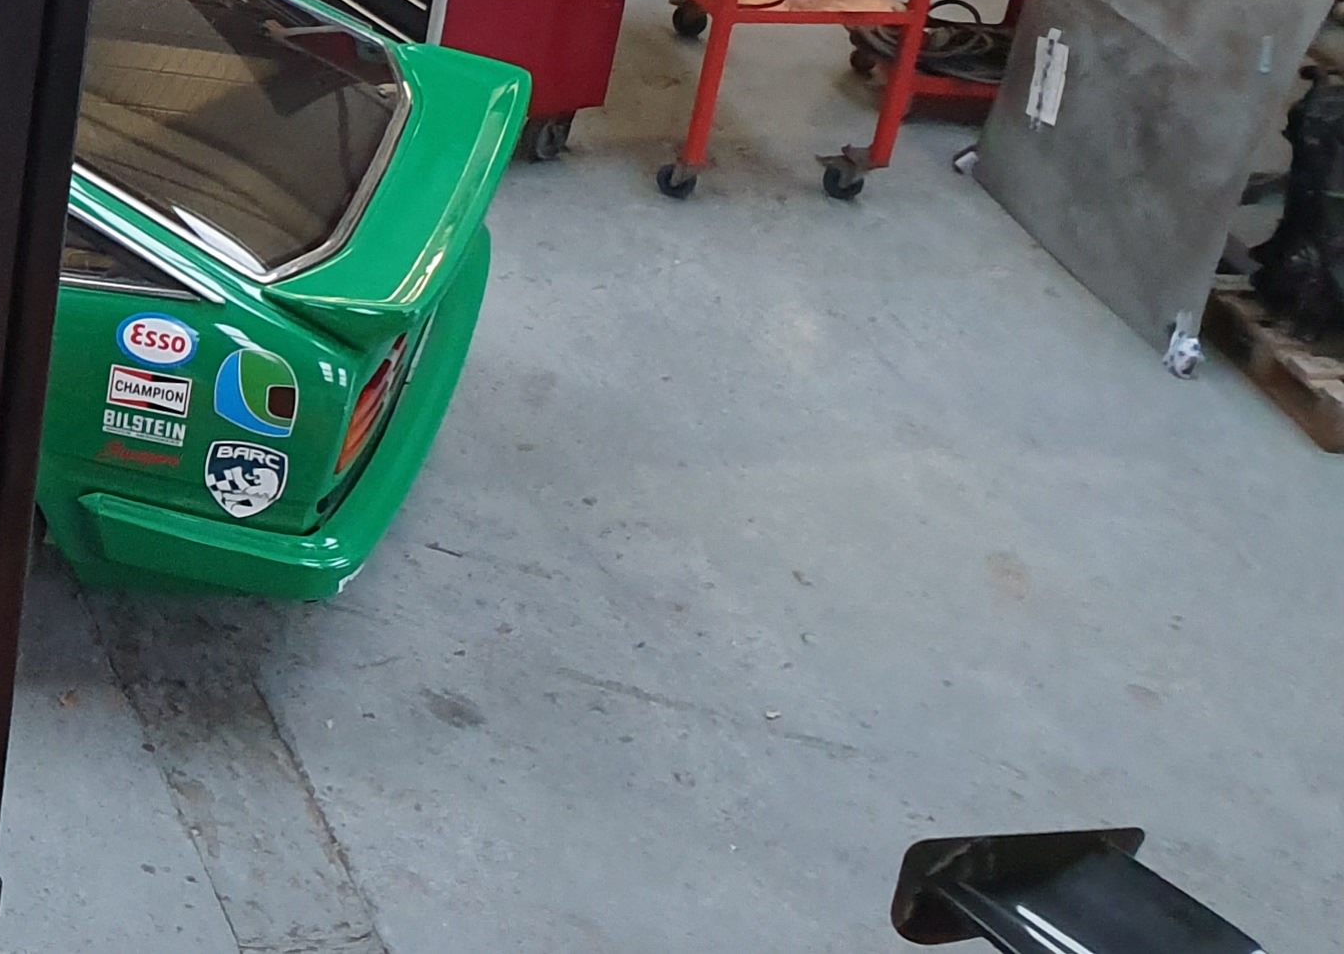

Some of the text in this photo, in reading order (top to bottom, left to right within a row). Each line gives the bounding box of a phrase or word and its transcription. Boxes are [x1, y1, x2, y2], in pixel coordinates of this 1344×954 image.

[130, 322, 186, 354] Esso
[114, 379, 185, 405] CHAMPION
[103, 408, 187, 440] BILSTEIN
[216, 445, 280, 470] BARC
